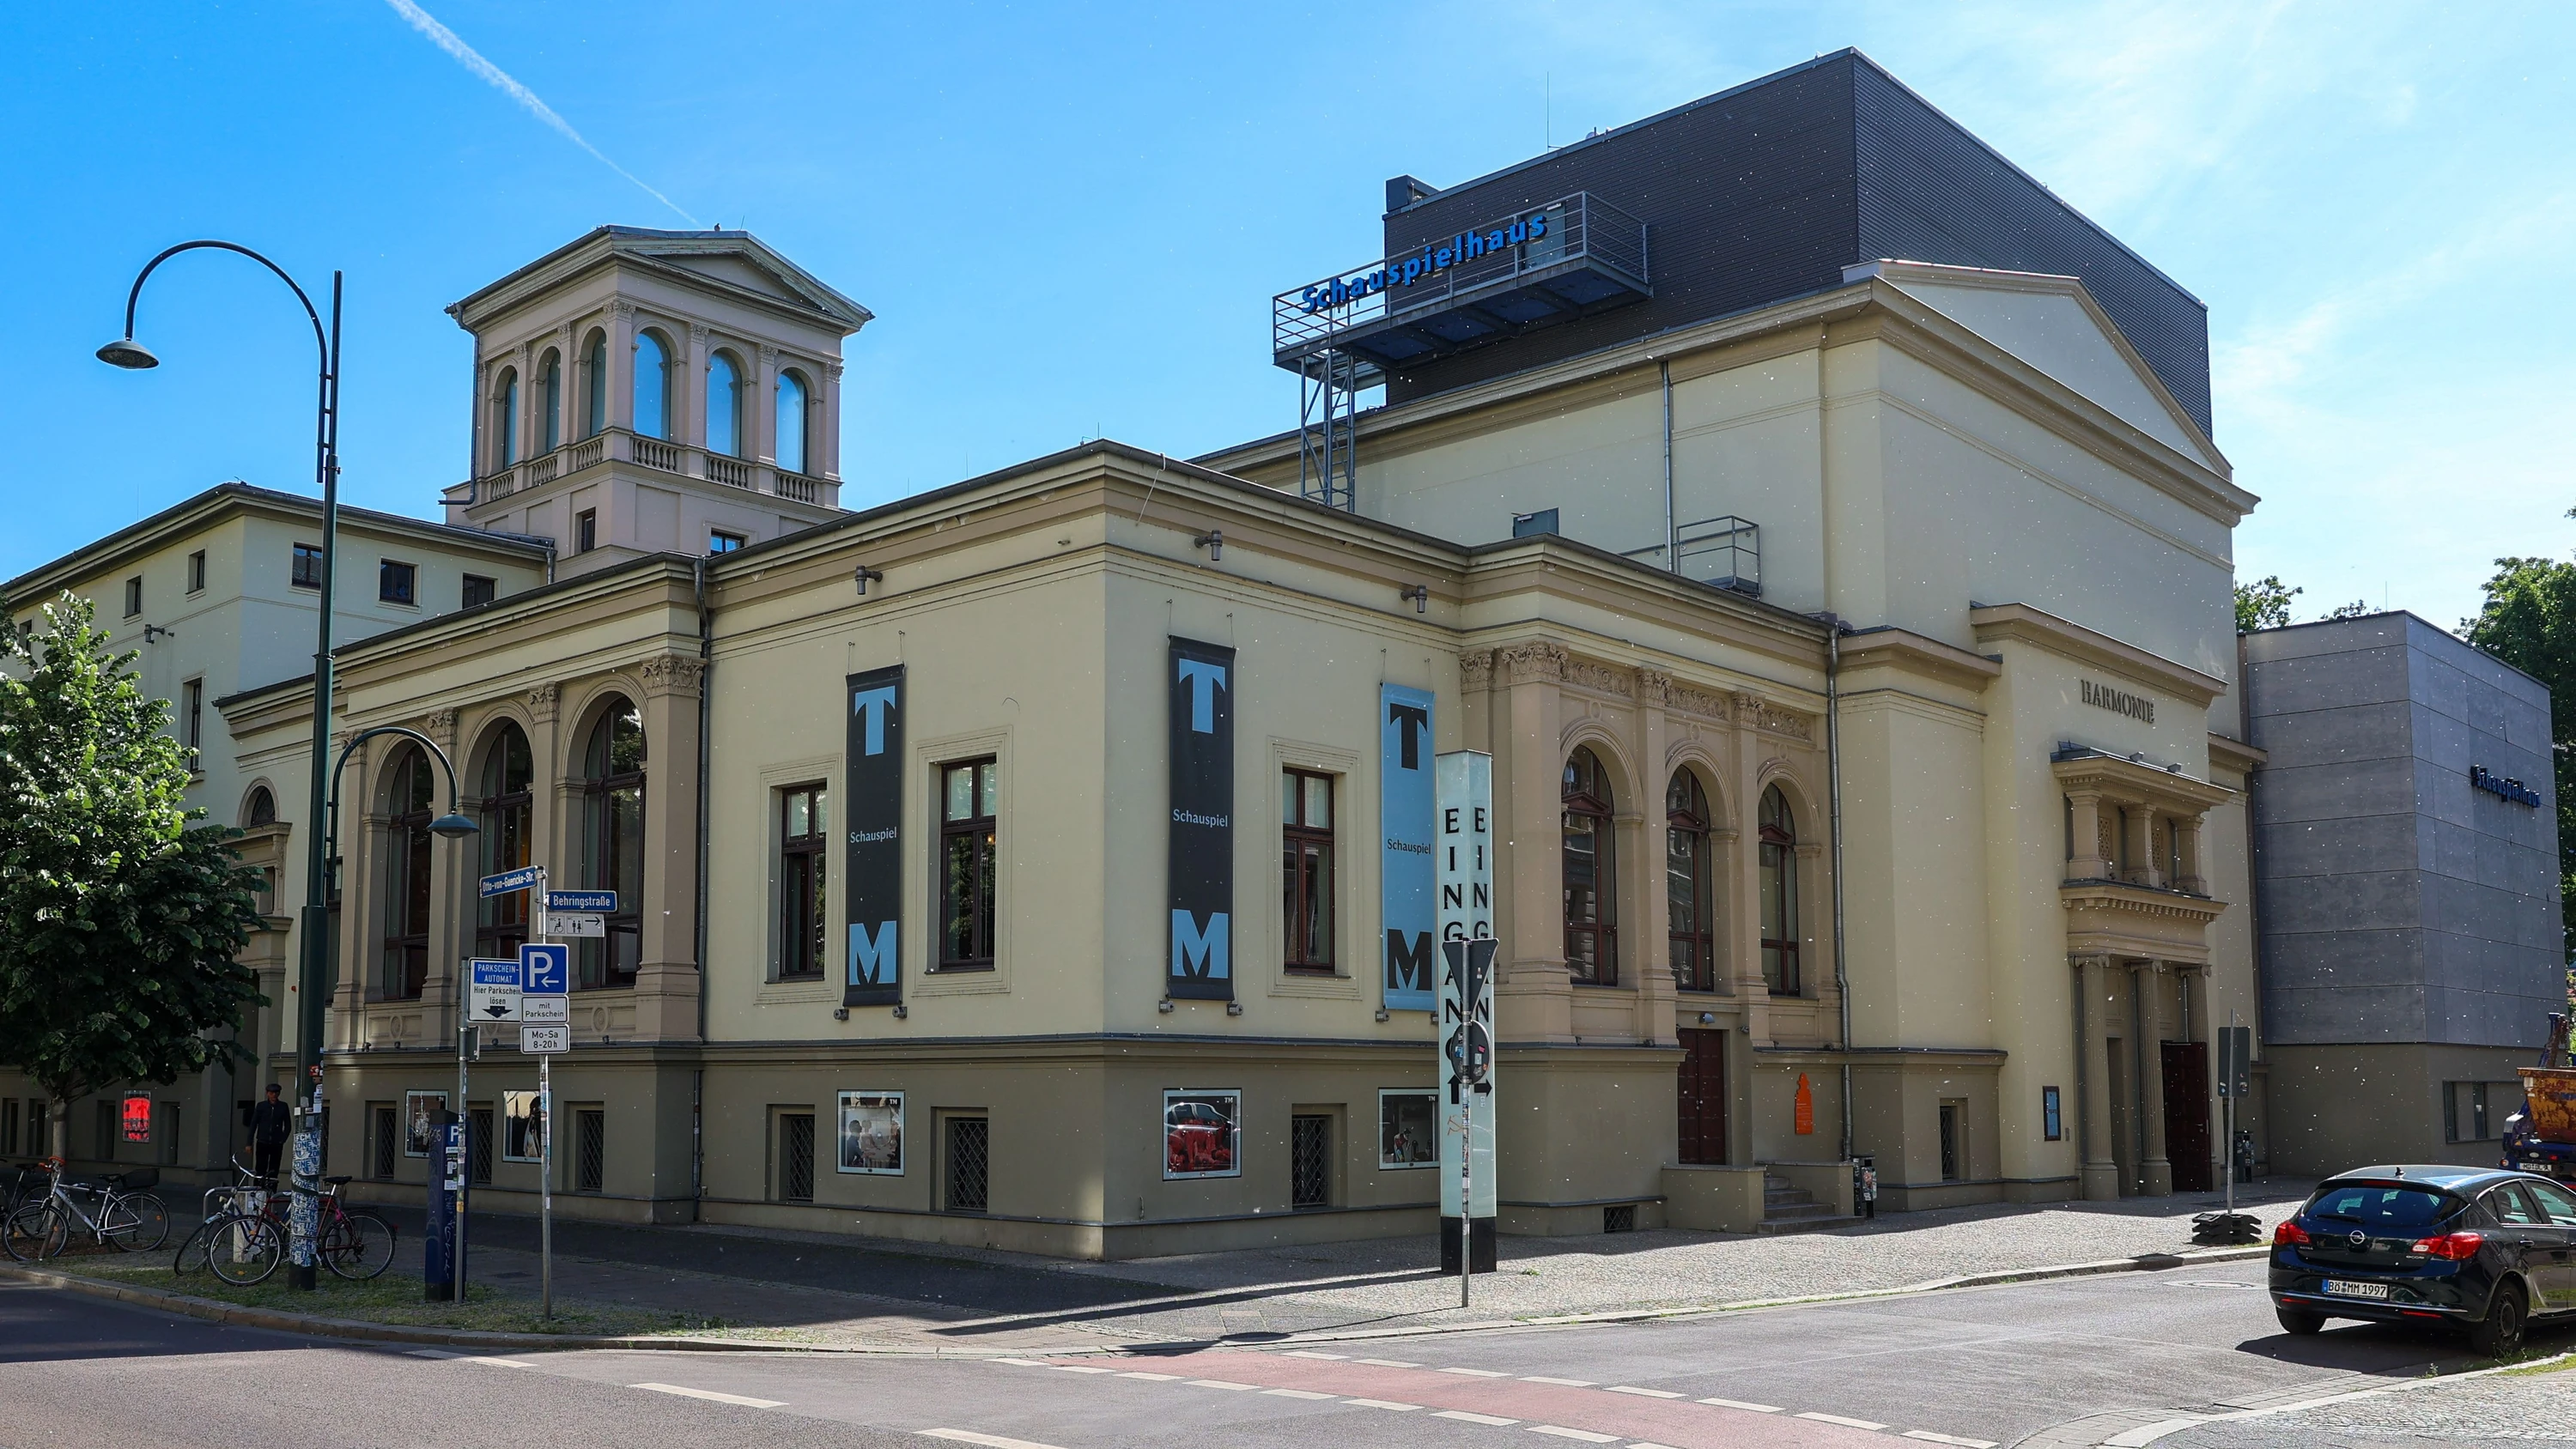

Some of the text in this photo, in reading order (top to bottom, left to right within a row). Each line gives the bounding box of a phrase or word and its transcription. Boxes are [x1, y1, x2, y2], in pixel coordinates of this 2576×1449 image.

[1301, 215, 1547, 313] Schauspielhaus
[1178, 658, 1226, 734] T
[2081, 679, 2155, 724] HARMONIE
[854, 685, 896, 756] T
[1389, 702, 1429, 771] T
[849, 826, 897, 844] Schauspiel
[1172, 808, 1229, 828] Schauspiel
[1387, 838, 1431, 856] Schauspiel
[483, 871, 535, 893] Otto-von-Guericke-Str.
[553, 895, 611, 909] Behringstraße
[848, 920, 897, 985] M
[1172, 908, 1229, 979] M
[1387, 928, 1432, 991] M
[477, 964, 519, 973] PARKSCHEIN-
[529, 951, 554, 987] P
[489, 997, 506, 1005] lösen
[2328, 1281, 2386, 1296] BÖ MM 1997
